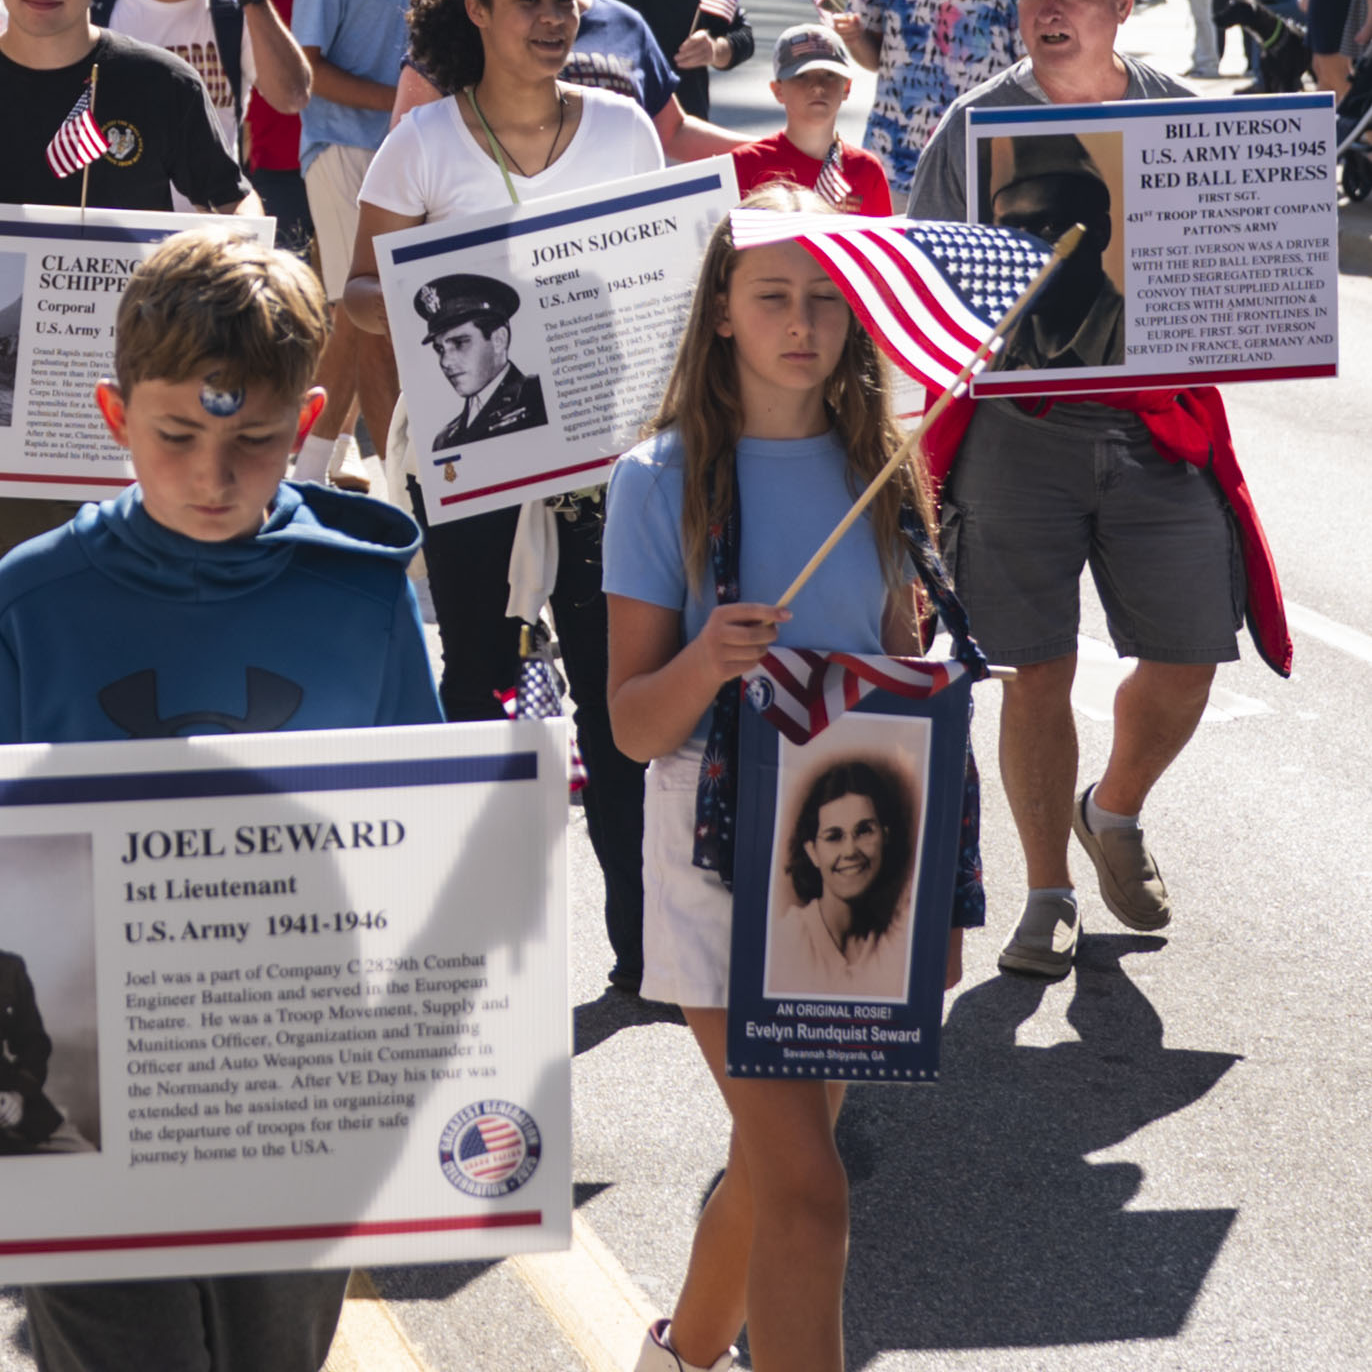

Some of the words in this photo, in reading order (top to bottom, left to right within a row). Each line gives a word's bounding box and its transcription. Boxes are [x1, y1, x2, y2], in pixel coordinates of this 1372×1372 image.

[1166, 123, 1209, 139] BILL
[1216, 118, 1301, 136] IVERSON
[1142, 149, 1176, 164] U.S.
[1183, 145, 1240, 162] ARMY
[1248, 141, 1326, 159] 1943-1945
[1141, 173, 1180, 189] RED
[1187, 170, 1236, 187] BALL
[1243, 165, 1327, 184] EXPRESS
[1198, 192, 1231, 203] FIRST
[1234, 191, 1260, 201] SGT.
[1157, 210, 1197, 221] TROOP
[1200, 206, 1270, 219] TRANSPORT
[1274, 203, 1332, 215] COMPANY
[1184, 224, 1241, 236] PATTON'S
[1245, 222, 1278, 232] ARMY
[532, 240, 583, 267] JOHN
[588, 219, 677, 251] SJOGREN
[1131, 247, 1164, 258] FIRST
[1166, 245, 1191, 256] SGT.
[1195, 243, 1245, 255] IVERSON
[1248, 242, 1273, 252] WAS
[1276, 240, 1283, 250] A
[1286, 238, 1330, 249] DRIVER
[42, 255, 141, 274] CLARENC
[1132, 260, 1163, 271] WITH
[1166, 259, 1189, 270] THE
[1192, 258, 1218, 268] RED
[1219, 257, 1249, 266] BALL
[1307, 252, 1329, 262] THE
[40, 274, 128, 292] SCHIPPE
[535, 269, 580, 288] Sergent
[1148, 273, 1191, 284] FAMED
[1193, 268, 1271, 282] SEGREGATED
[1274, 267, 1315, 278] TRUCK
[539, 294, 565, 309] U.S.
[568, 287, 600, 303] Army
[607, 270, 664, 293] 1943-1945
[1137, 288, 1186, 299] CONVOY
[1190, 286, 1221, 296] THAT
[1224, 283, 1280, 294] SUPPLIED
[1282, 280, 1325, 291] ALLIED
[37, 300, 95, 315] Corporal
[36, 322, 62, 334] U.S.
[65, 324, 101, 339] Army
[1188, 352, 1275, 366] SWITZERLAND.
[122, 829, 224, 864] JOEL
[236, 819, 405, 856] SEWARD
[126, 882, 156, 902] 1st
[166, 876, 296, 900] Lieutenant
[125, 921, 174, 943] U.S.
[182, 921, 248, 943] Army
[267, 908, 387, 937] 1941-1946
[126, 971, 156, 986] Joel
[162, 973, 191, 984] was
[197, 972, 206, 983] a
[211, 969, 240, 986] part
[245, 965, 262, 980] of
[266, 962, 341, 980] Company
[348, 960, 359, 974] C
[423, 953, 486, 970] Combat
[126, 994, 195, 1012] Engineer
[202, 987, 272, 1005] Battalion
[278, 986, 306, 1001] and
[310, 985, 361, 999] served
[387, 981, 410, 995] the
[415, 976, 488, 993] European
[776, 1003, 794, 1016] AN
[796, 1004, 851, 1018] ORIGINAL
[854, 1003, 891, 1019] ROSIE!
[746, 1021, 793, 1041] Evelyn
[797, 1023, 867, 1043] Rundquist
[871, 1026, 920, 1043] Seward
[783, 1048, 825, 1059] Savannah
[826, 1049, 869, 1062] Shipyards,
[871, 1050, 885, 1061] GA
